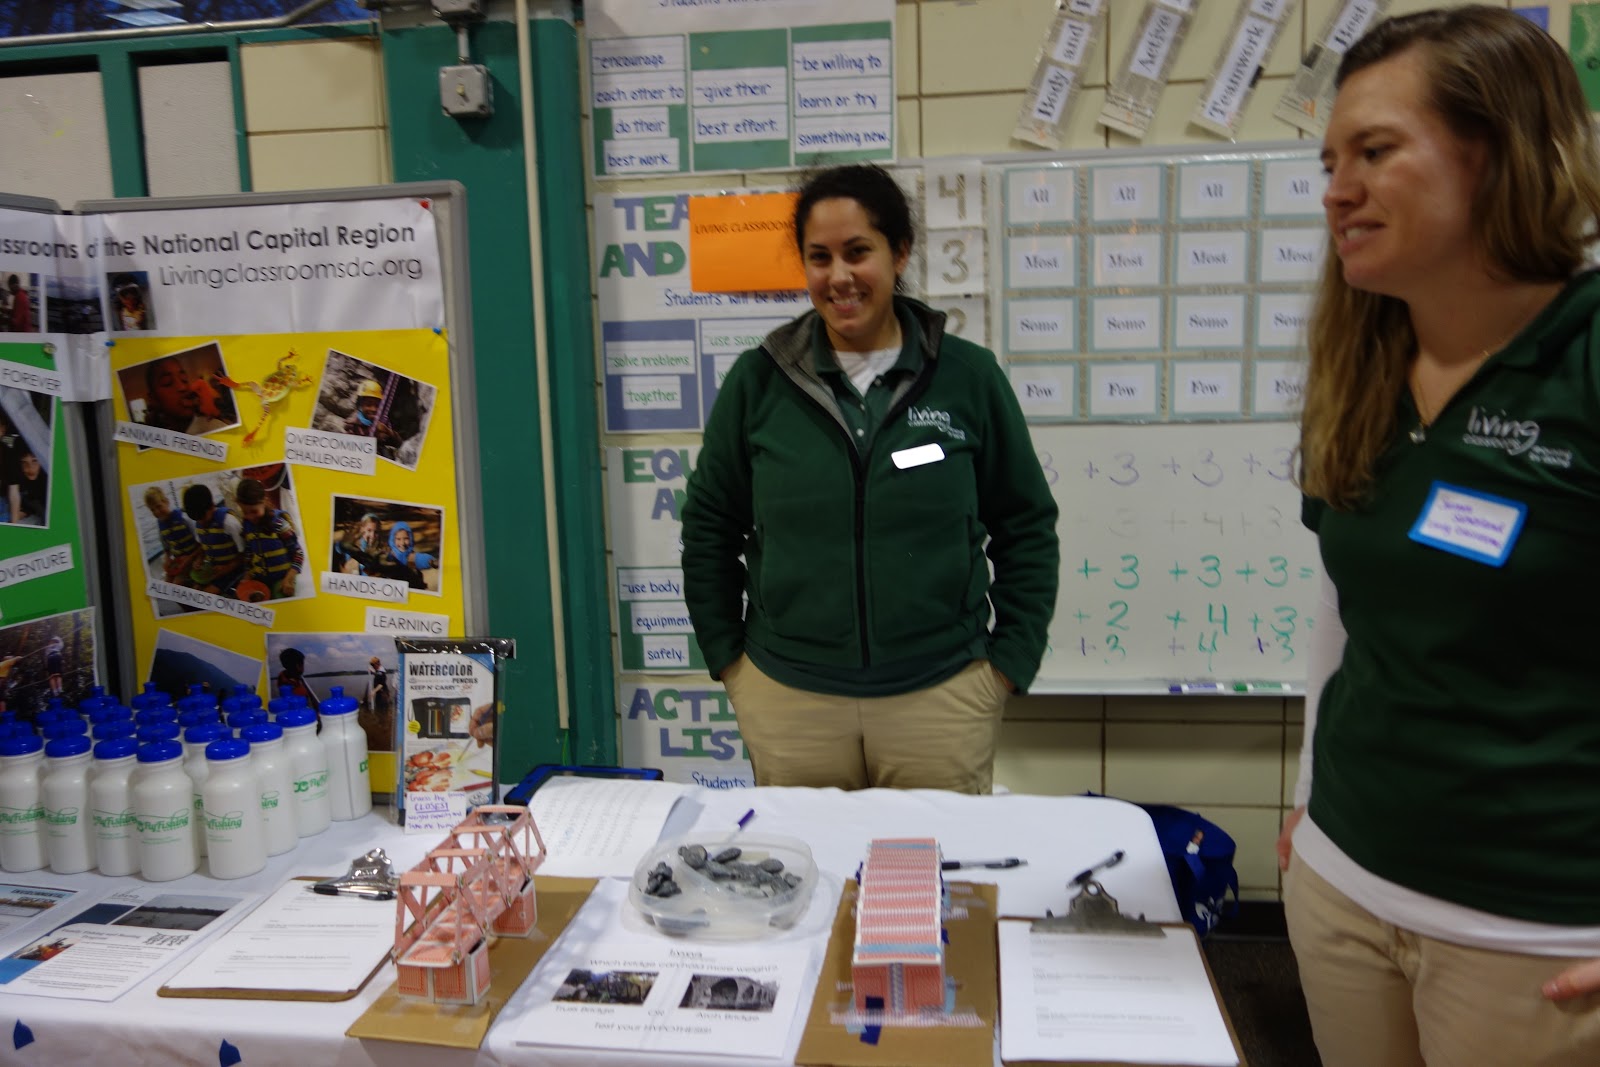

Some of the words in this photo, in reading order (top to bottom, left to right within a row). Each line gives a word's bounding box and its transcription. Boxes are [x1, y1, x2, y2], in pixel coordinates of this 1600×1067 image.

[1136, 13, 1174, 74] Active
[820, 53, 865, 74] willing
[868, 54, 882, 69] to
[1035, 68, 1074, 120] Body
[1062, 23, 1089, 60] and
[1207, 24, 1267, 121] Teamwork
[596, 87, 628, 103] each
[630, 86, 666, 102] other
[669, 86, 684, 100] to
[735, 82, 772, 97] their
[797, 92, 832, 109] learn
[835, 94, 850, 108] or
[855, 93, 877, 109] try
[615, 118, 631, 135] do
[633, 118, 666, 133] their
[697, 119, 728, 136] best
[798, 127, 862, 148] something
[606, 151, 637, 169] best
[938, 174, 967, 221] 4
[694, 223, 728, 236] LIVING
[0, 238, 79, 259] ssrooms
[143, 229, 240, 256] National
[249, 225, 330, 256] Capital
[338, 222, 416, 251] Region
[600, 241, 687, 278] AND
[941, 239, 971, 285] 3
[1023, 254, 1060, 270] Most
[1108, 253, 1145, 269] Most
[1191, 250, 1229, 266] Most
[1278, 248, 1315, 265] Most
[159, 256, 424, 290] Livingclassroomsdc.org
[664, 289, 721, 307] Students
[729, 291, 749, 305] will
[755, 291, 768, 303] be
[773, 290, 798, 304] able
[1274, 312, 1306, 328] Som
[642, 352, 690, 367] problems
[2, 367, 62, 392] FOREVER
[1466, 405, 1541, 457] living
[119, 426, 170, 447] ANIMAL
[172, 435, 224, 458] FRIENDS
[285, 431, 375, 455] OVERCOMING
[285, 448, 364, 471] CHALLENGES
[149, 582, 169, 597] ALL
[171, 587, 212, 607] HANDS
[214, 598, 235, 612] ON
[328, 577, 404, 599] HANDS-ON
[649, 579, 680, 596] body
[371, 614, 443, 635] LEARNING
[409, 664, 473, 676] WATERCOLOR
[692, 771, 747, 790] Students
